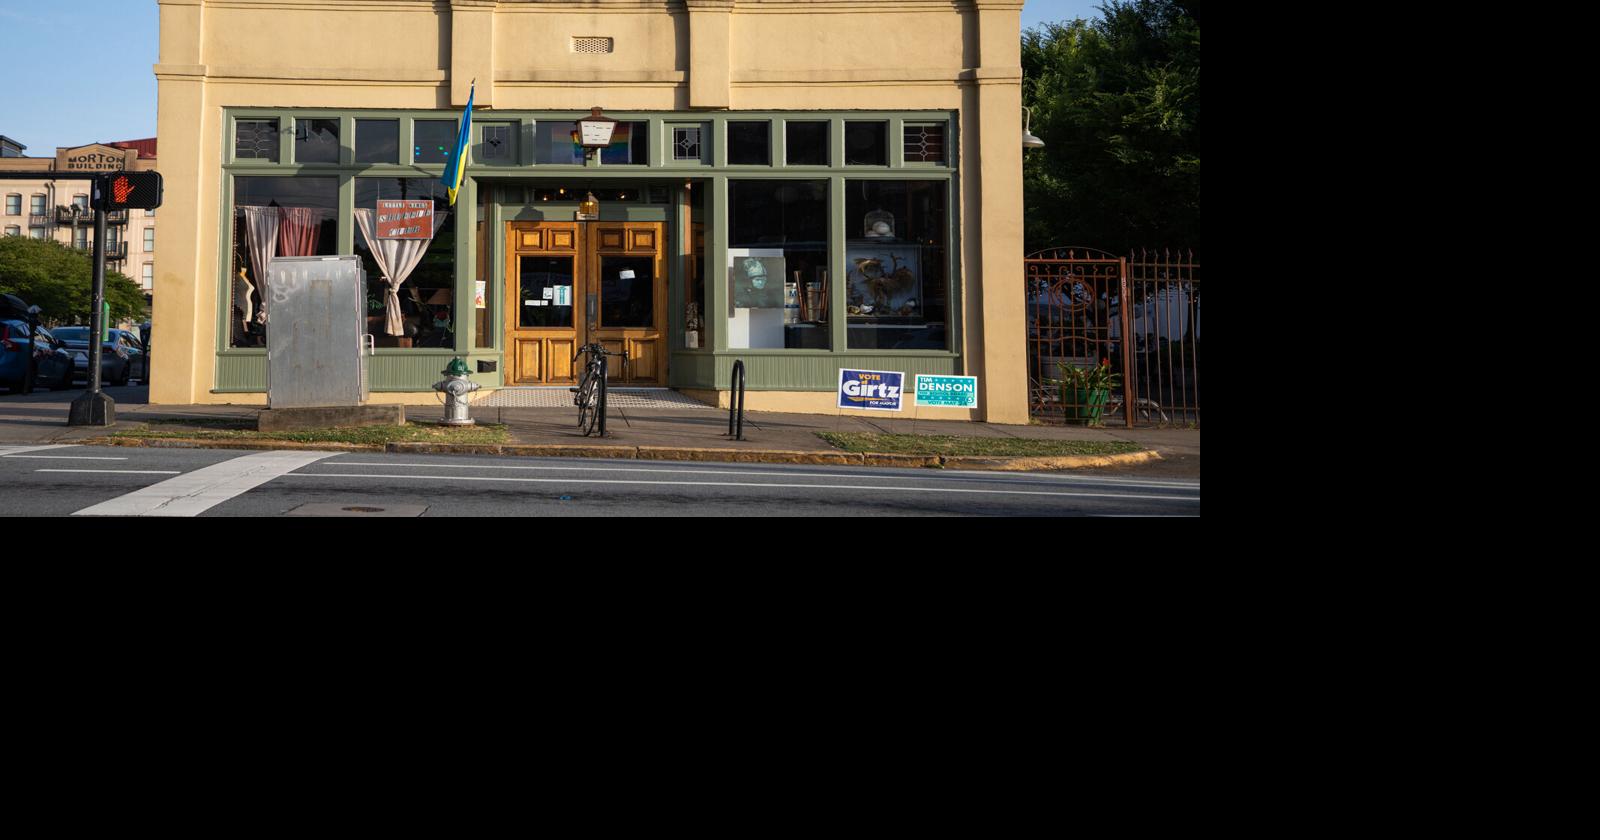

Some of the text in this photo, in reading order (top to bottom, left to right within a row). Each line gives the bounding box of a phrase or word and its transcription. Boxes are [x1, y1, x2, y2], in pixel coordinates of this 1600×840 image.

[68, 153, 123, 163] MORTON
[842, 380, 900, 398] Girtz
[919, 382, 973, 392] DENSON
